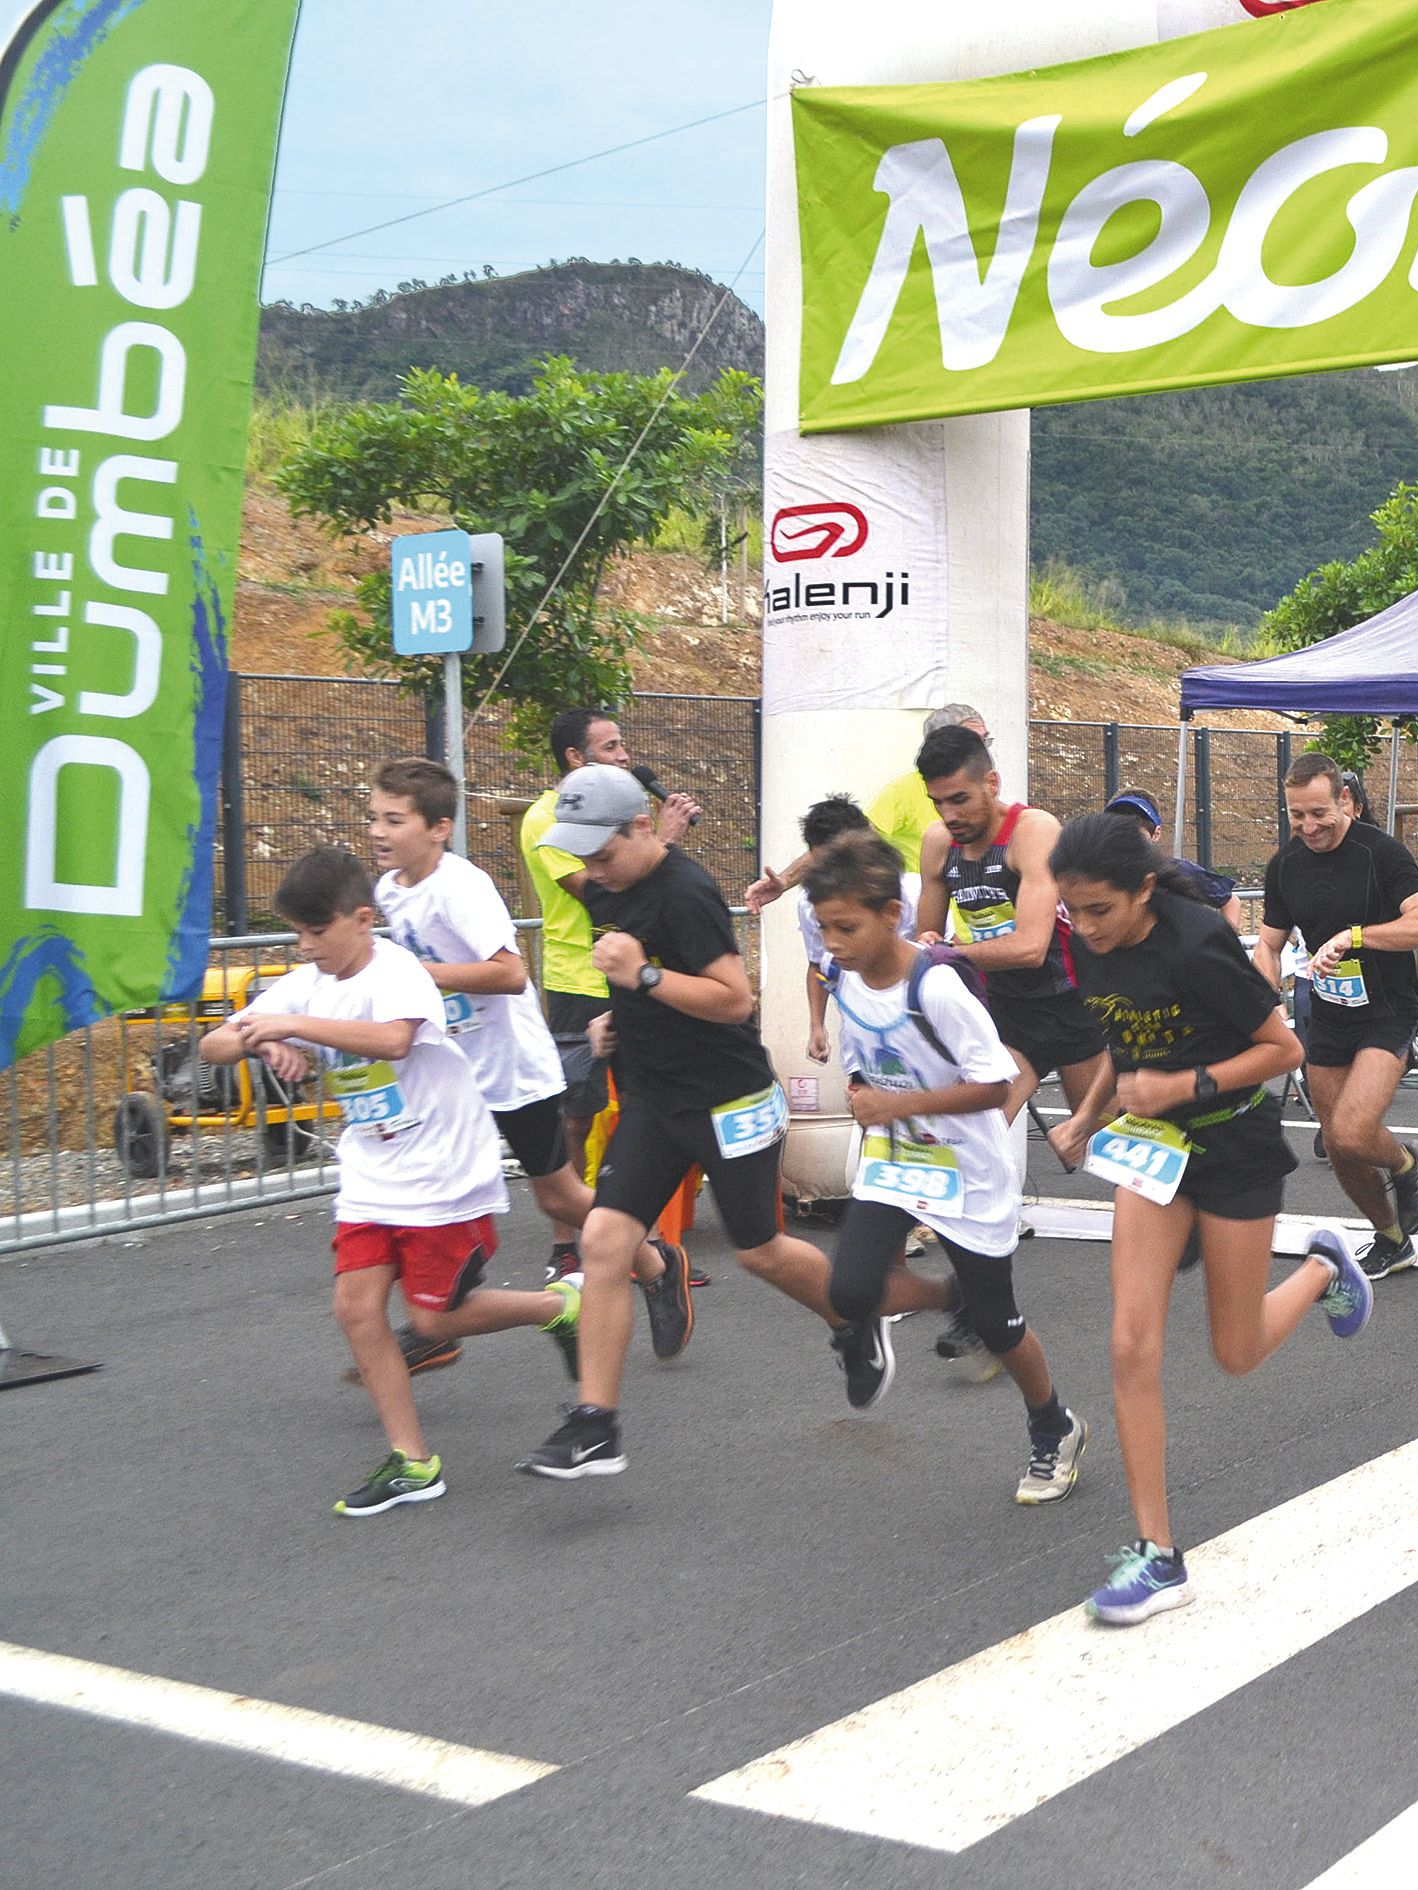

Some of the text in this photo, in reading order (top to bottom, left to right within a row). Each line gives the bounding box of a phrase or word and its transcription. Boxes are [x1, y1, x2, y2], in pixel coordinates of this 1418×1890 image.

[29, 447, 80, 715] VILLE DE
[397, 550, 465, 592] Allée
[410, 599, 453, 636] M3
[832, 611, 853, 622] your
[854, 611, 871, 620] run
[1102, 1136, 1171, 1177] 441
[873, 1163, 951, 1199] 398
